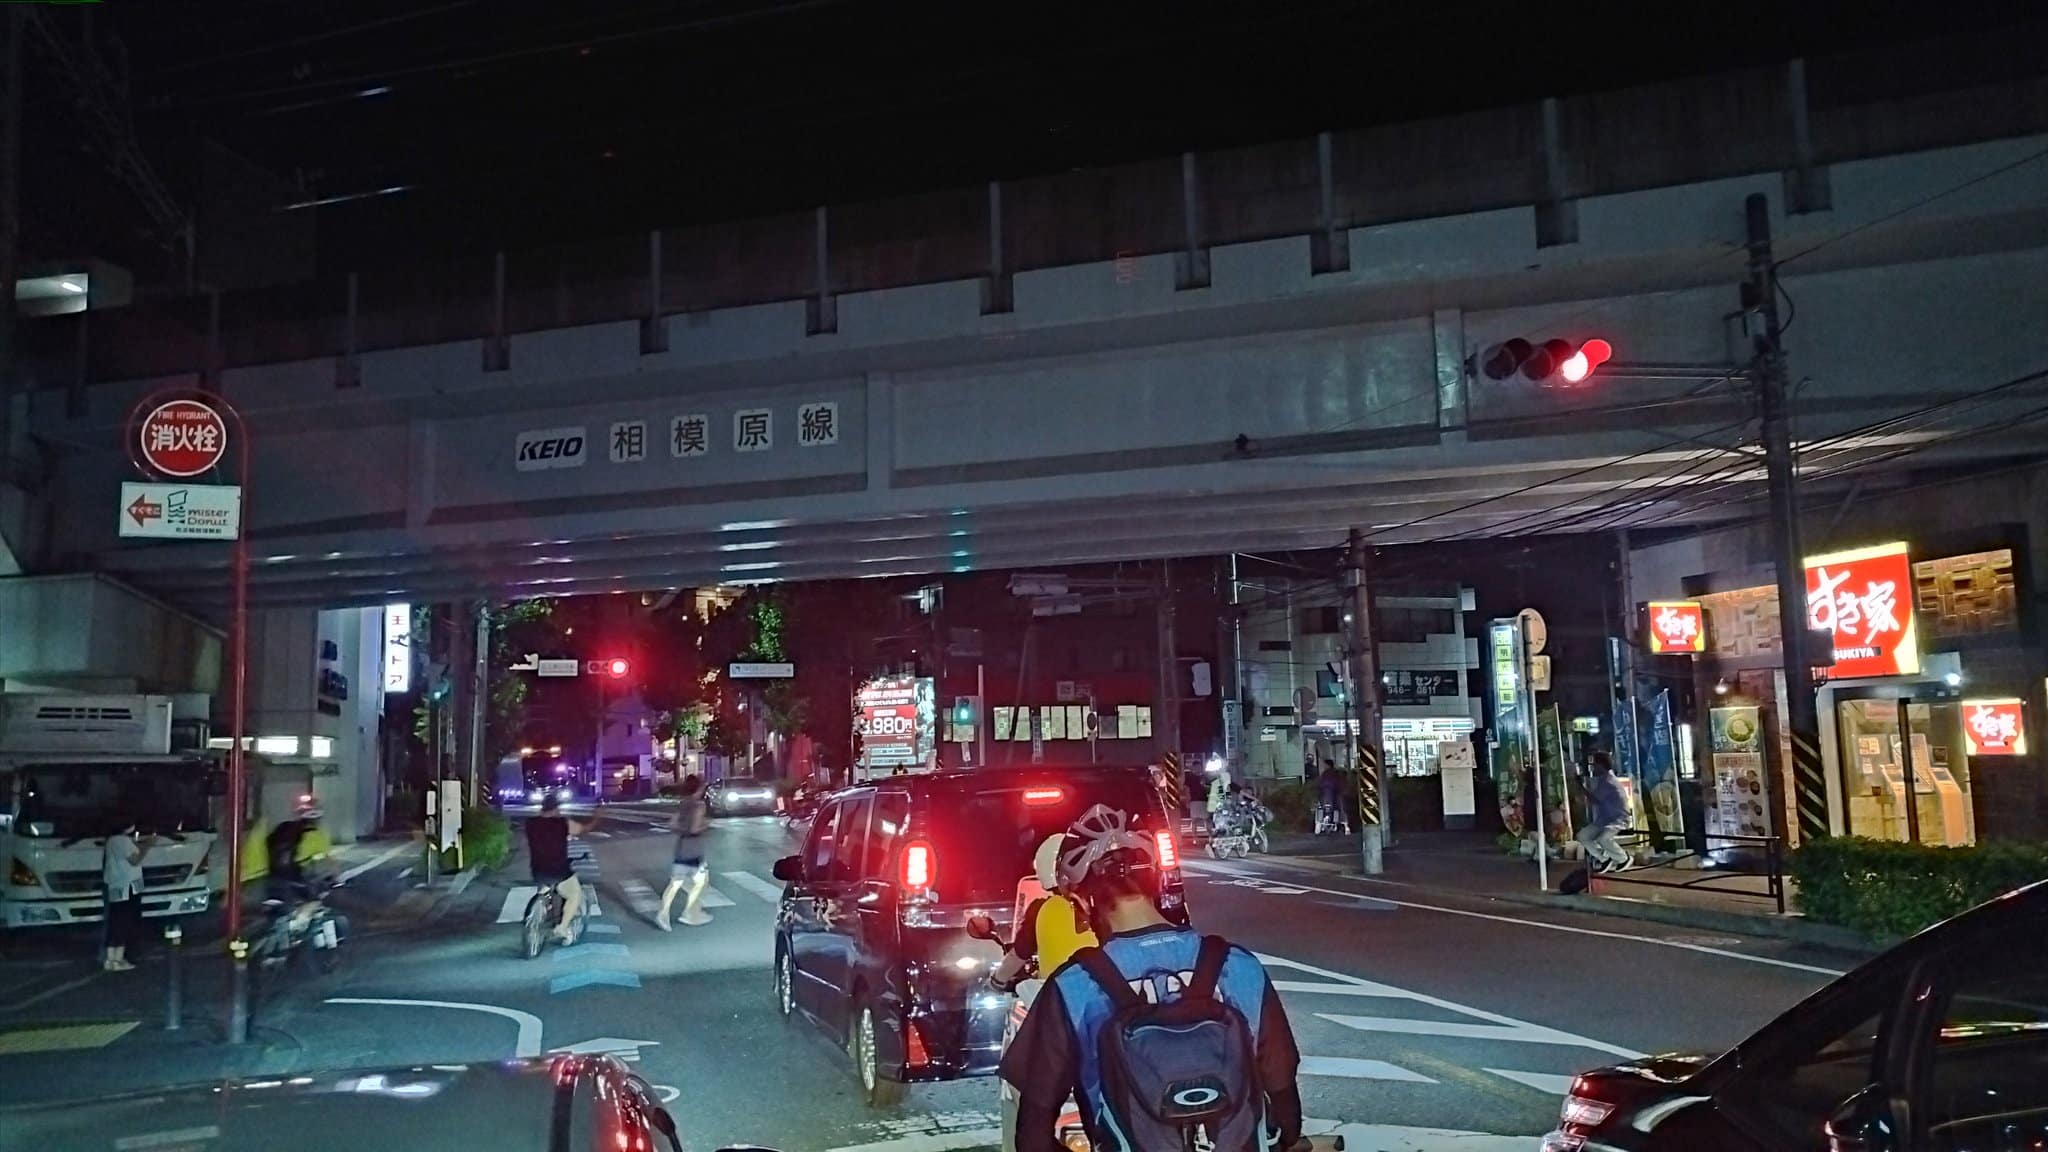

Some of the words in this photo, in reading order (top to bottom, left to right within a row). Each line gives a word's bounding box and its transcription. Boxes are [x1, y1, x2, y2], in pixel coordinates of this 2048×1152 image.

[157, 411, 175, 420] FIRE
[176, 411, 211, 420] HYDRANT
[151, 423, 218, 452] 消火栓
[518, 436, 583, 462] KEIO
[612, 406, 835, 460] 相模原線
[187, 509, 229, 517] mister
[187, 517, 228, 526] Donut
[1807, 567, 1900, 645] すき家
[1656, 606, 1697, 640] すき家
[1969, 705, 2017, 741] すき家
